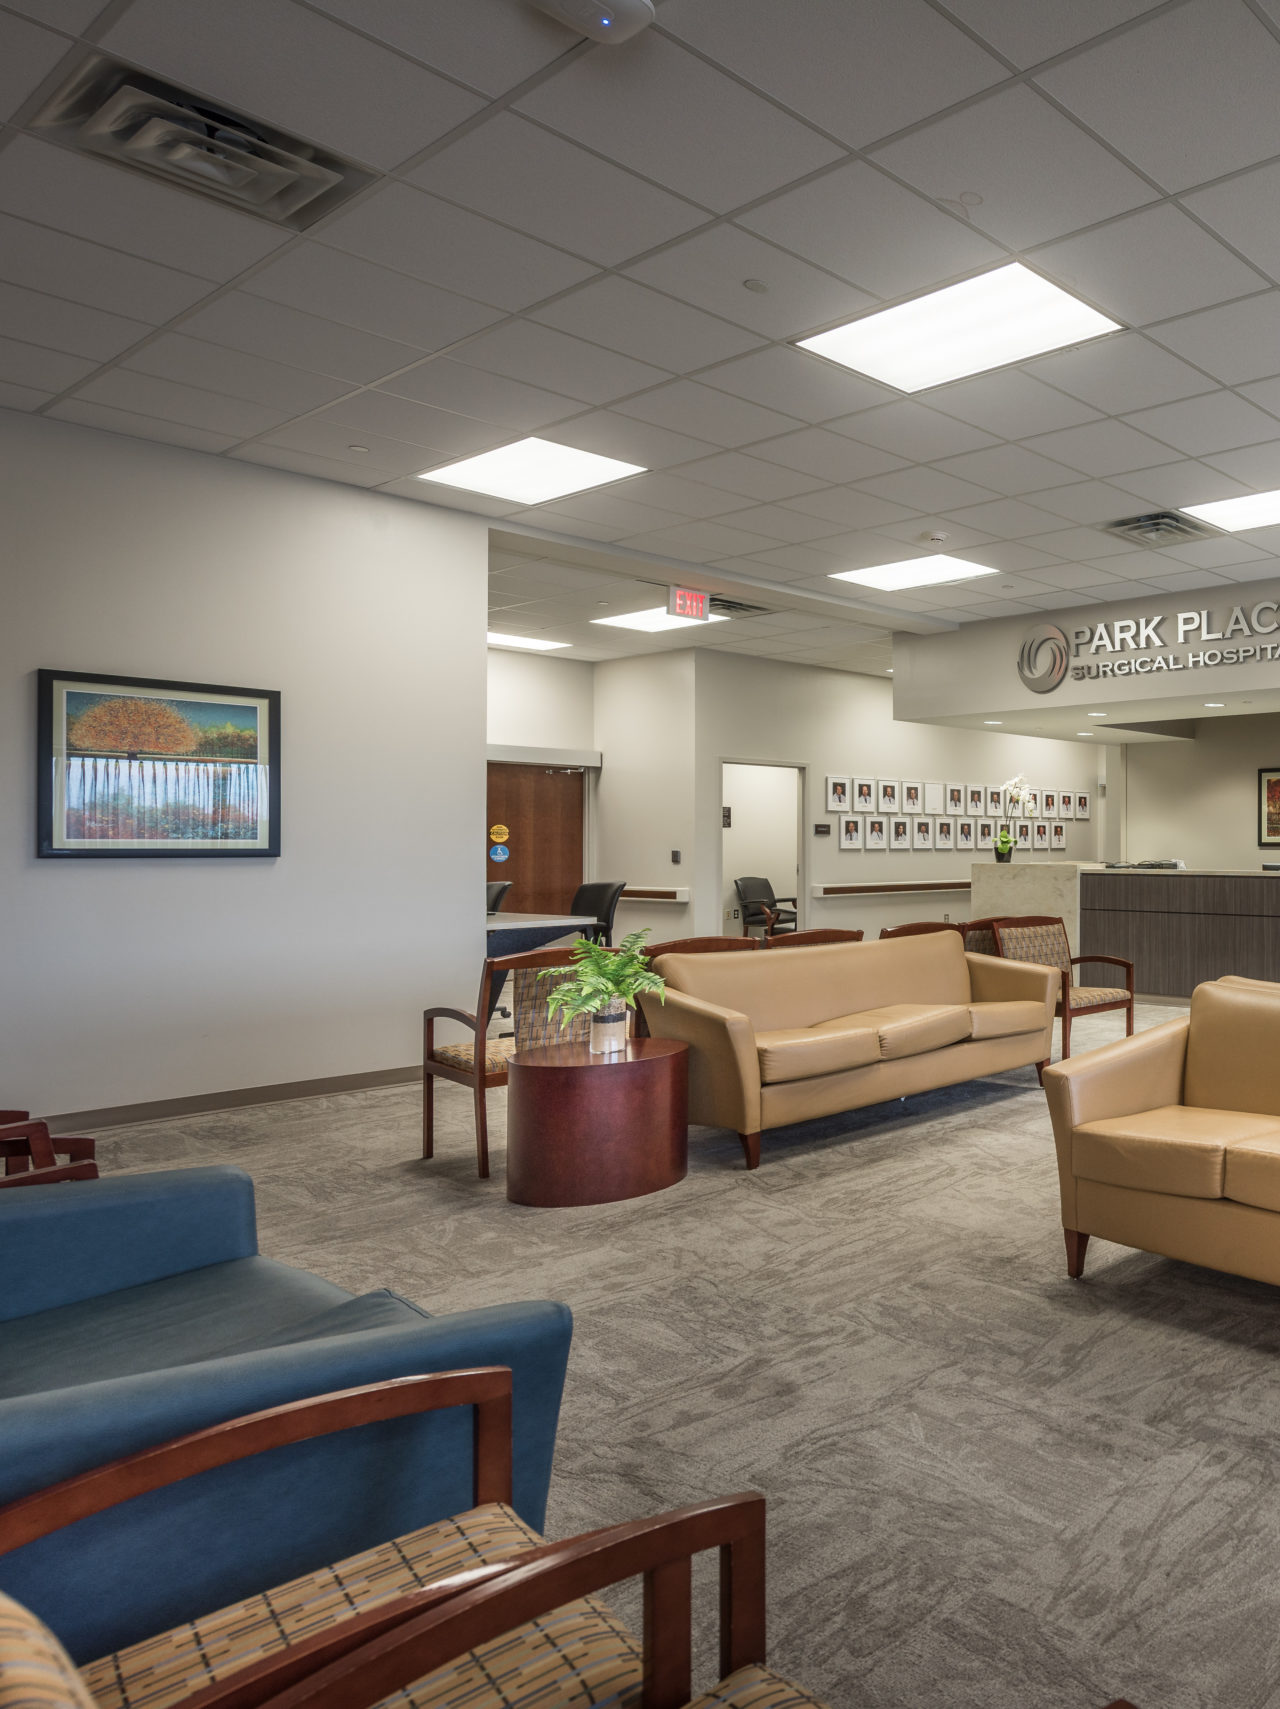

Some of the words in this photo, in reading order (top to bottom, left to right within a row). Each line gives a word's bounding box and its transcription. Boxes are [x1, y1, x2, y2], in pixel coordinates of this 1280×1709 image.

[676, 590, 705, 617] EXIT
[1073, 615, 1164, 658] PARK
[1071, 654, 1183, 680] SURGICAL
